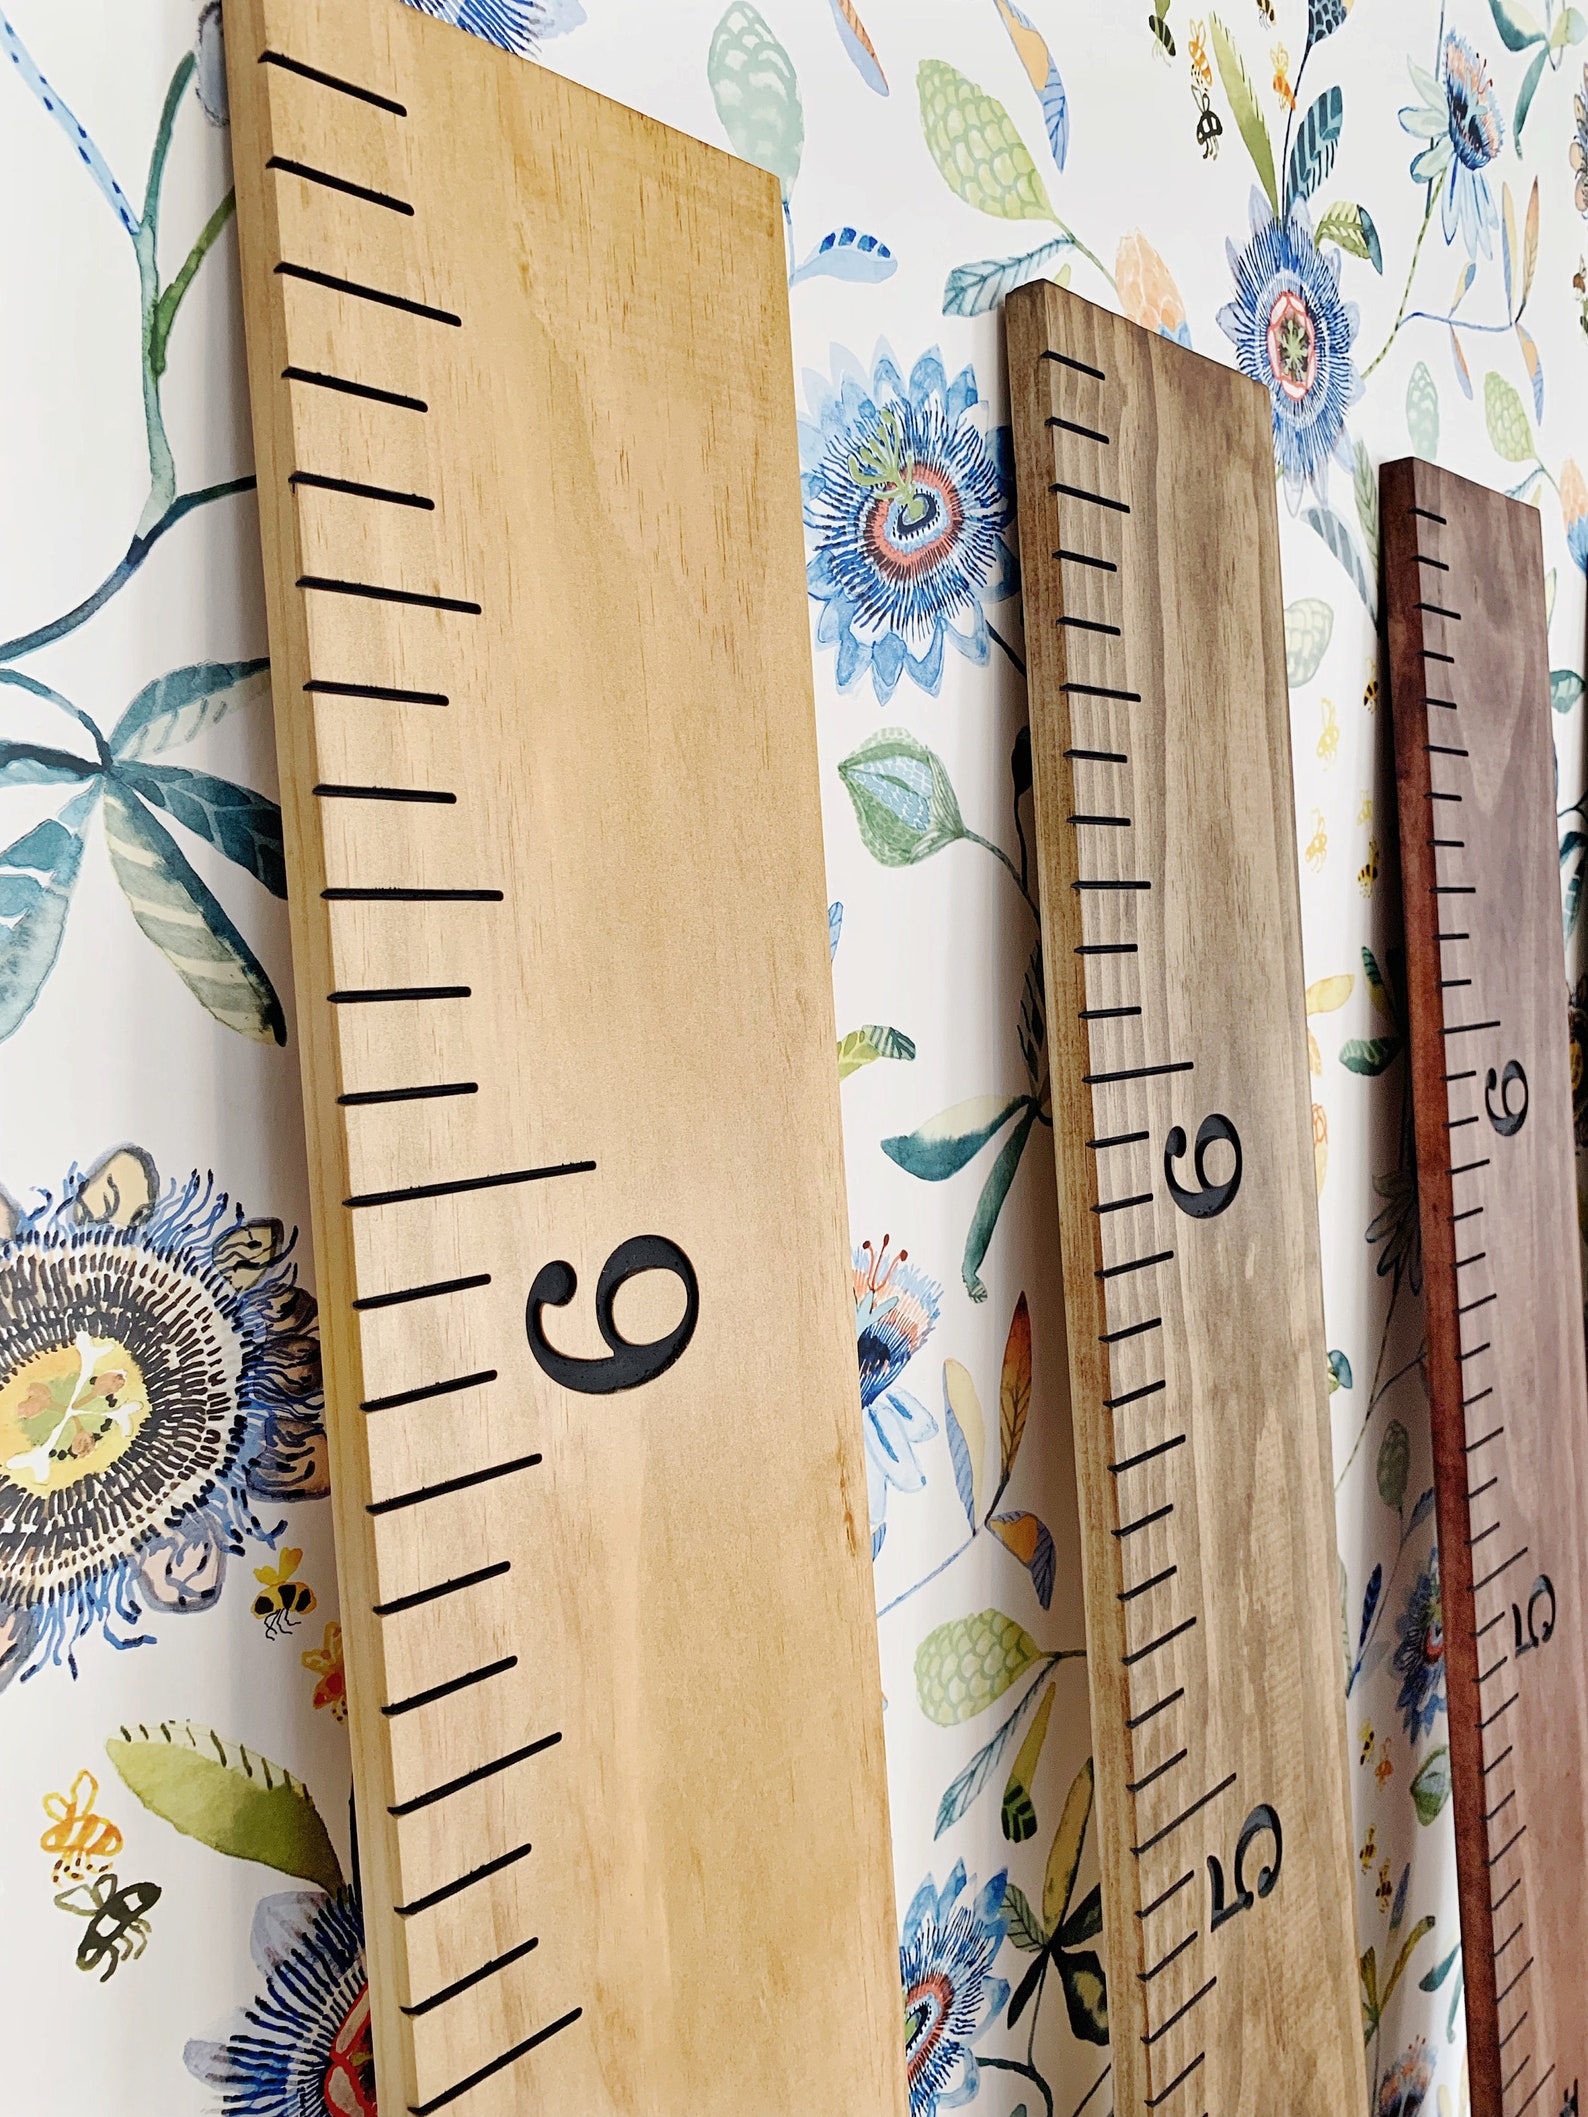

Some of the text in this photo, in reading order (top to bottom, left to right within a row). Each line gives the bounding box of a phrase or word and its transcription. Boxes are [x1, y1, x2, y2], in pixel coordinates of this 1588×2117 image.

[1485, 1059, 1529, 1136] 6
[1163, 1113, 1243, 1219] 6
[525, 1234, 699, 1395] 6
[1512, 1574, 1556, 1659] 5
[1206, 1803, 1283, 1933] 5
